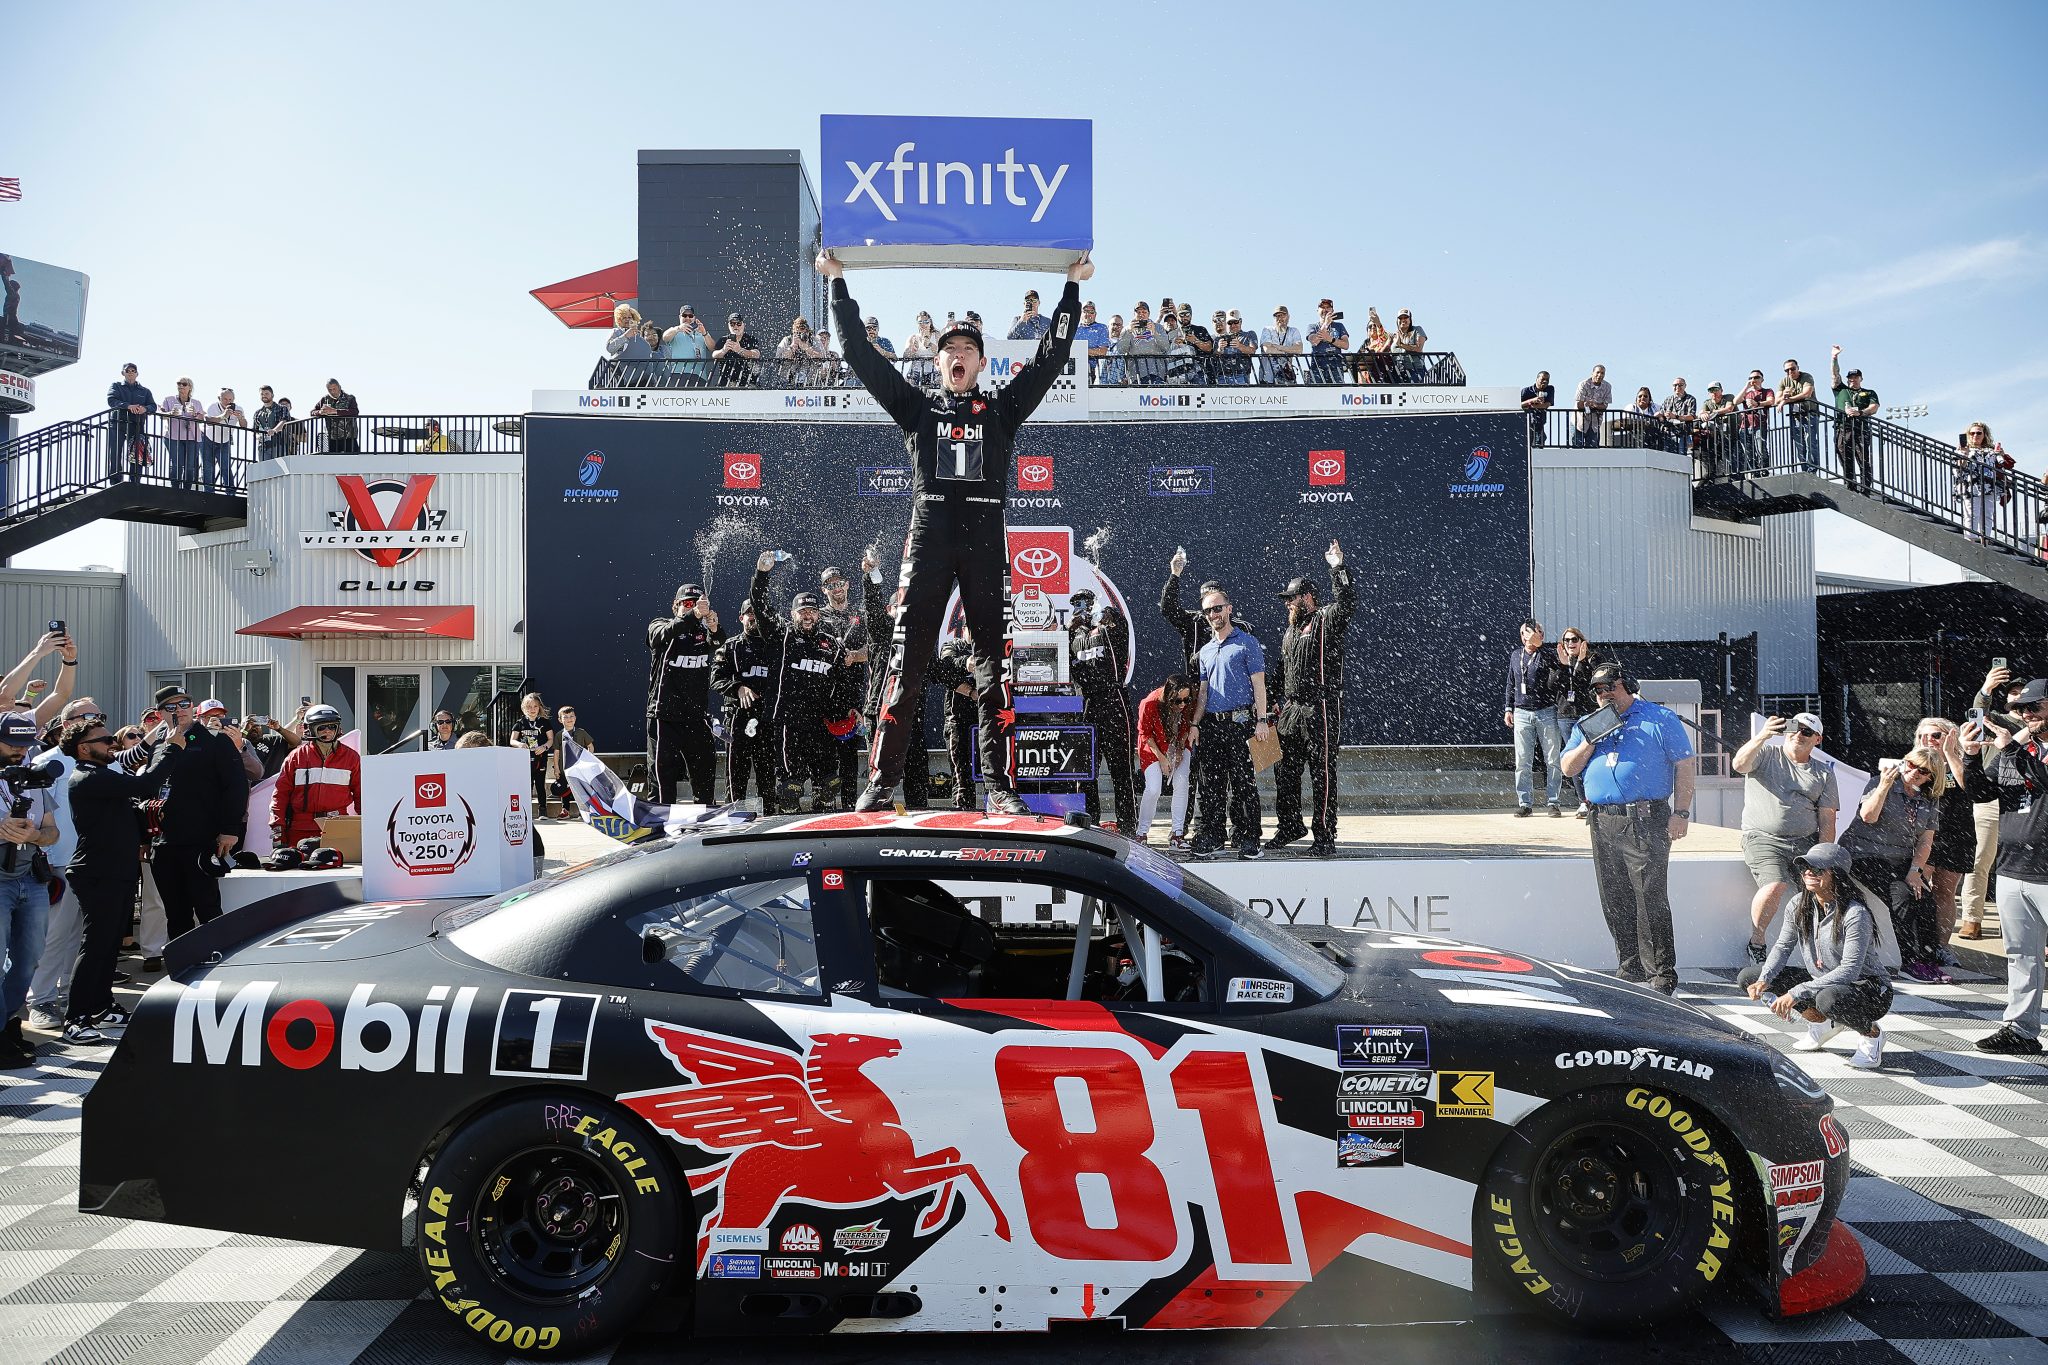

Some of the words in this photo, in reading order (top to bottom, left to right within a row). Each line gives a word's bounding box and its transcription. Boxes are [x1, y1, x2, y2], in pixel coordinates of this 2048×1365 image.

[845, 142, 1069, 222] xfinity
[4, 387, 29, 400] TIRE
[1045, 393, 1077, 403] LANE
[1139, 393, 1175, 407] Mobil
[1210, 395, 1257, 406] VICTORY
[1259, 395, 1289, 405] LANE
[1341, 393, 1378, 406] Mobil
[1411, 393, 1457, 404] VICTORY
[1461, 393, 1490, 404] LANE
[579, 395, 616, 407] Mobil
[651, 397, 699, 407] VICTORY
[701, 397, 731, 407] LANE
[785, 395, 822, 407] Mobil
[937, 421, 983, 440] Mobil
[951, 442, 966, 476] 1
[869, 475, 911, 490] xfinity
[1160, 475, 1202, 490] xfinity
[1450, 483, 1505, 493] RICHMOND
[564, 488, 619, 498] RICHMOND
[1301, 492, 1354, 503] TOYOTA
[716, 495, 769, 506] TOYOTA
[1010, 498, 1061, 508] TOYOTA
[304, 536, 394, 544] VICTORY
[409, 535, 459, 543] LANE
[339, 580, 435, 592] CLUB
[669, 654, 708, 669] JGR
[791, 658, 833, 675] JGR
[741, 665, 769, 678] JG
[1018, 685, 1049, 693] WINNER
[1019, 730, 1060, 741] NASCAR
[1020, 744, 1075, 771] inity
[1017, 766, 1051, 776] SERIES
[630, 782, 644, 793] 81
[408, 814, 454, 825] TOYOTA
[399, 829, 465, 844] ToyotaCare
[415, 844, 448, 860] 250
[880, 848, 961, 859] CHANDLER
[960, 848, 1046, 862] SMITH
[1325, 895, 1451, 932] LANE
[1250, 980, 1286, 992] NASCAR
[1237, 991, 1263, 999] RACE
[1265, 991, 1285, 999] CAR
[172, 980, 480, 1073] Mobil
[528, 997, 561, 1069] 1
[1371, 1029, 1402, 1037] NASCAR
[1353, 1038, 1414, 1059] xfinity
[1555, 1048, 1715, 1081] GOODYEAR
[1342, 1074, 1429, 1093] COMETIC
[1341, 1101, 1408, 1113] LINCOLN
[1438, 1107, 1492, 1117] KENNAMETAL
[1356, 1116, 1416, 1126] WELDERS
[1338, 1137, 1402, 1151] Arrowhead
[573, 1115, 661, 1195] EAGLE
[994, 1044, 1293, 1266] 81
[1770, 1162, 1823, 1189] SIMPSON
[1625, 1087, 1735, 1282] GOODYEAR
[1775, 1186, 1823, 1208] ARP
[716, 1234, 762, 1243] SIEMENS
[782, 1226, 820, 1243] MAC
[836, 1232, 887, 1240] INTERSTATE
[782, 1243, 820, 1251] TOOLS
[838, 1238, 883, 1246] BATTERIES
[1491, 1193, 1552, 1295] EAGLE
[424, 1186, 561, 1350] GOODYEAR
[729, 1258, 756, 1266] SHERWIN
[767, 1259, 811, 1269] LINCOLN
[776, 1269, 816, 1278] WELDERS
[824, 1262, 869, 1277] Mobil
